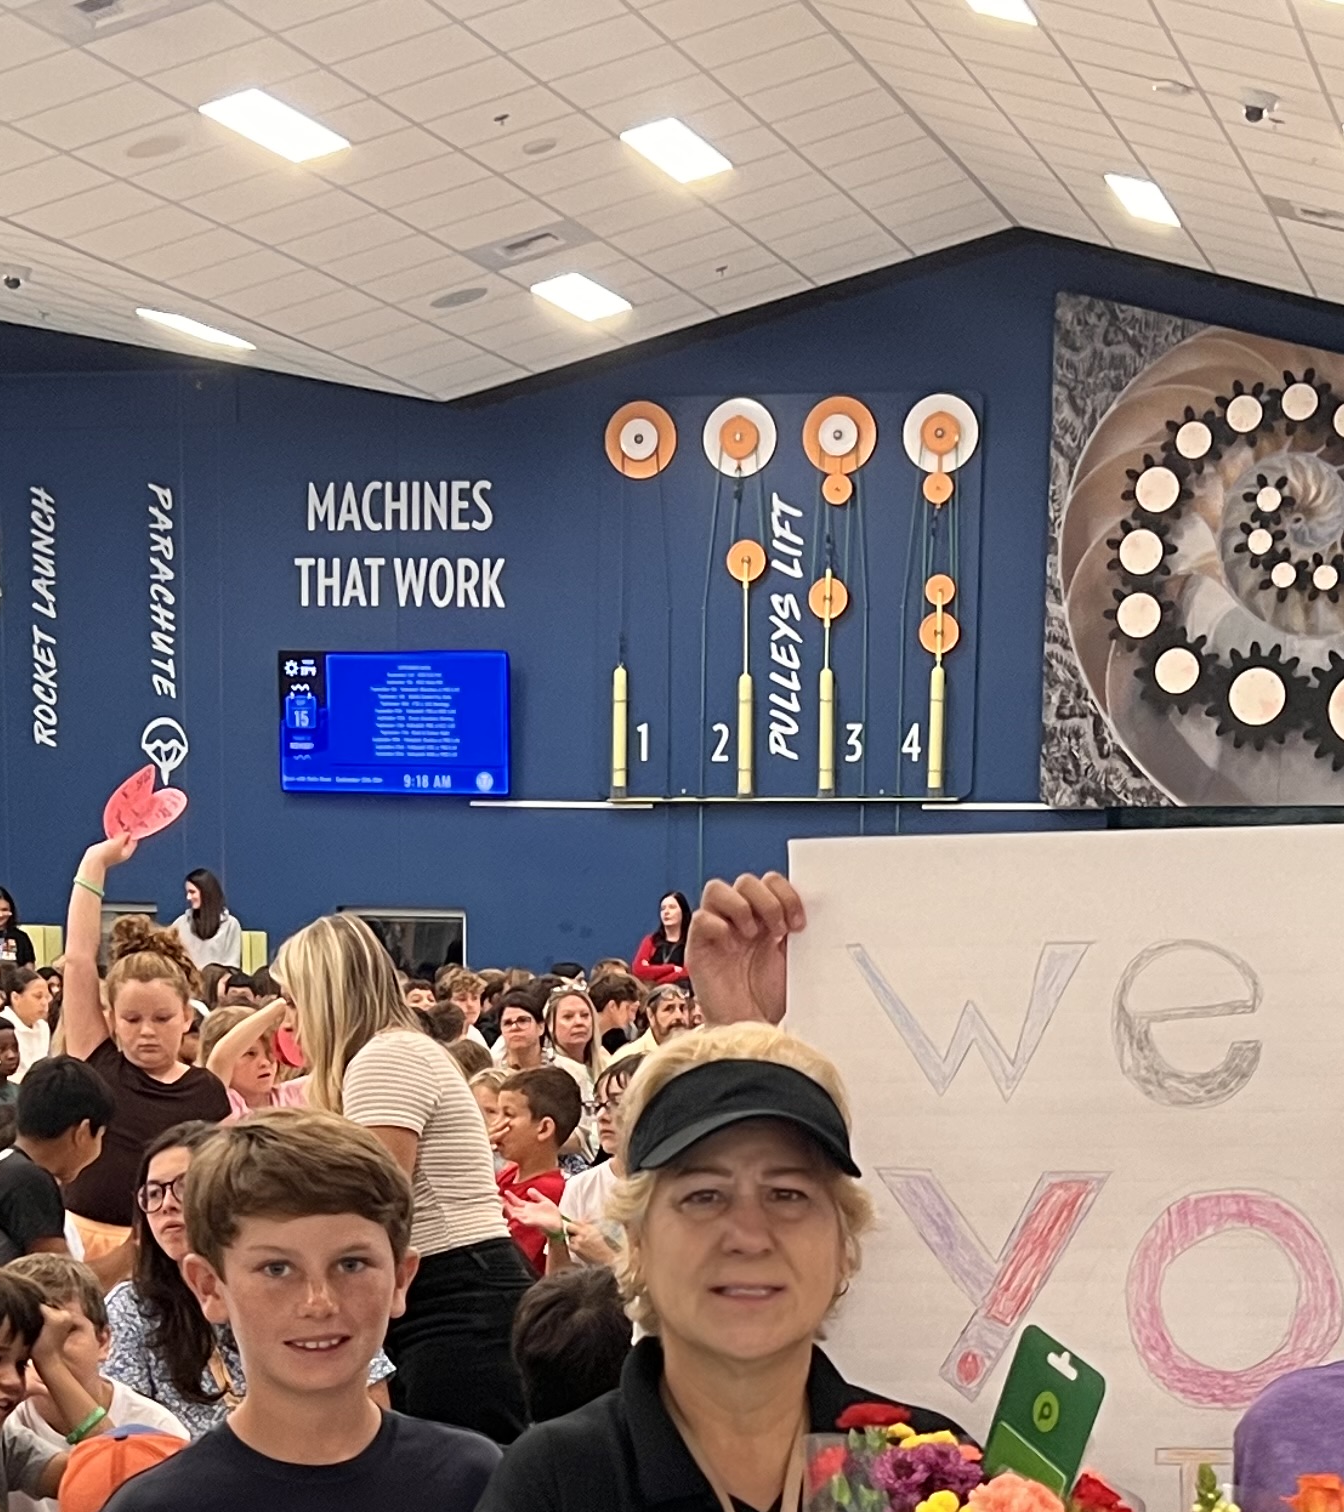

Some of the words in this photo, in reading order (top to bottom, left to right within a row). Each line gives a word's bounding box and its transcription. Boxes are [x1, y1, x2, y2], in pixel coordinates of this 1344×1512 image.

[306, 479, 494, 533] MACHINES
[30, 485, 57, 619] LAUNCH
[771, 493, 805, 580] LIFT
[147, 480, 177, 700] PARACHUTE
[294, 557, 385, 609] THAT
[393, 556, 506, 609] WORK
[32, 624, 58, 749] ROCKET
[768, 590, 805, 761] PULLEYS
[294, 710, 309, 728] 15
[637, 723, 650, 762] 1
[711, 723, 730, 762] 2
[844, 723, 863, 762] 3
[901, 723, 922, 762] 4
[403, 773, 429, 789] 9:18
[433, 774, 452, 789] AM
